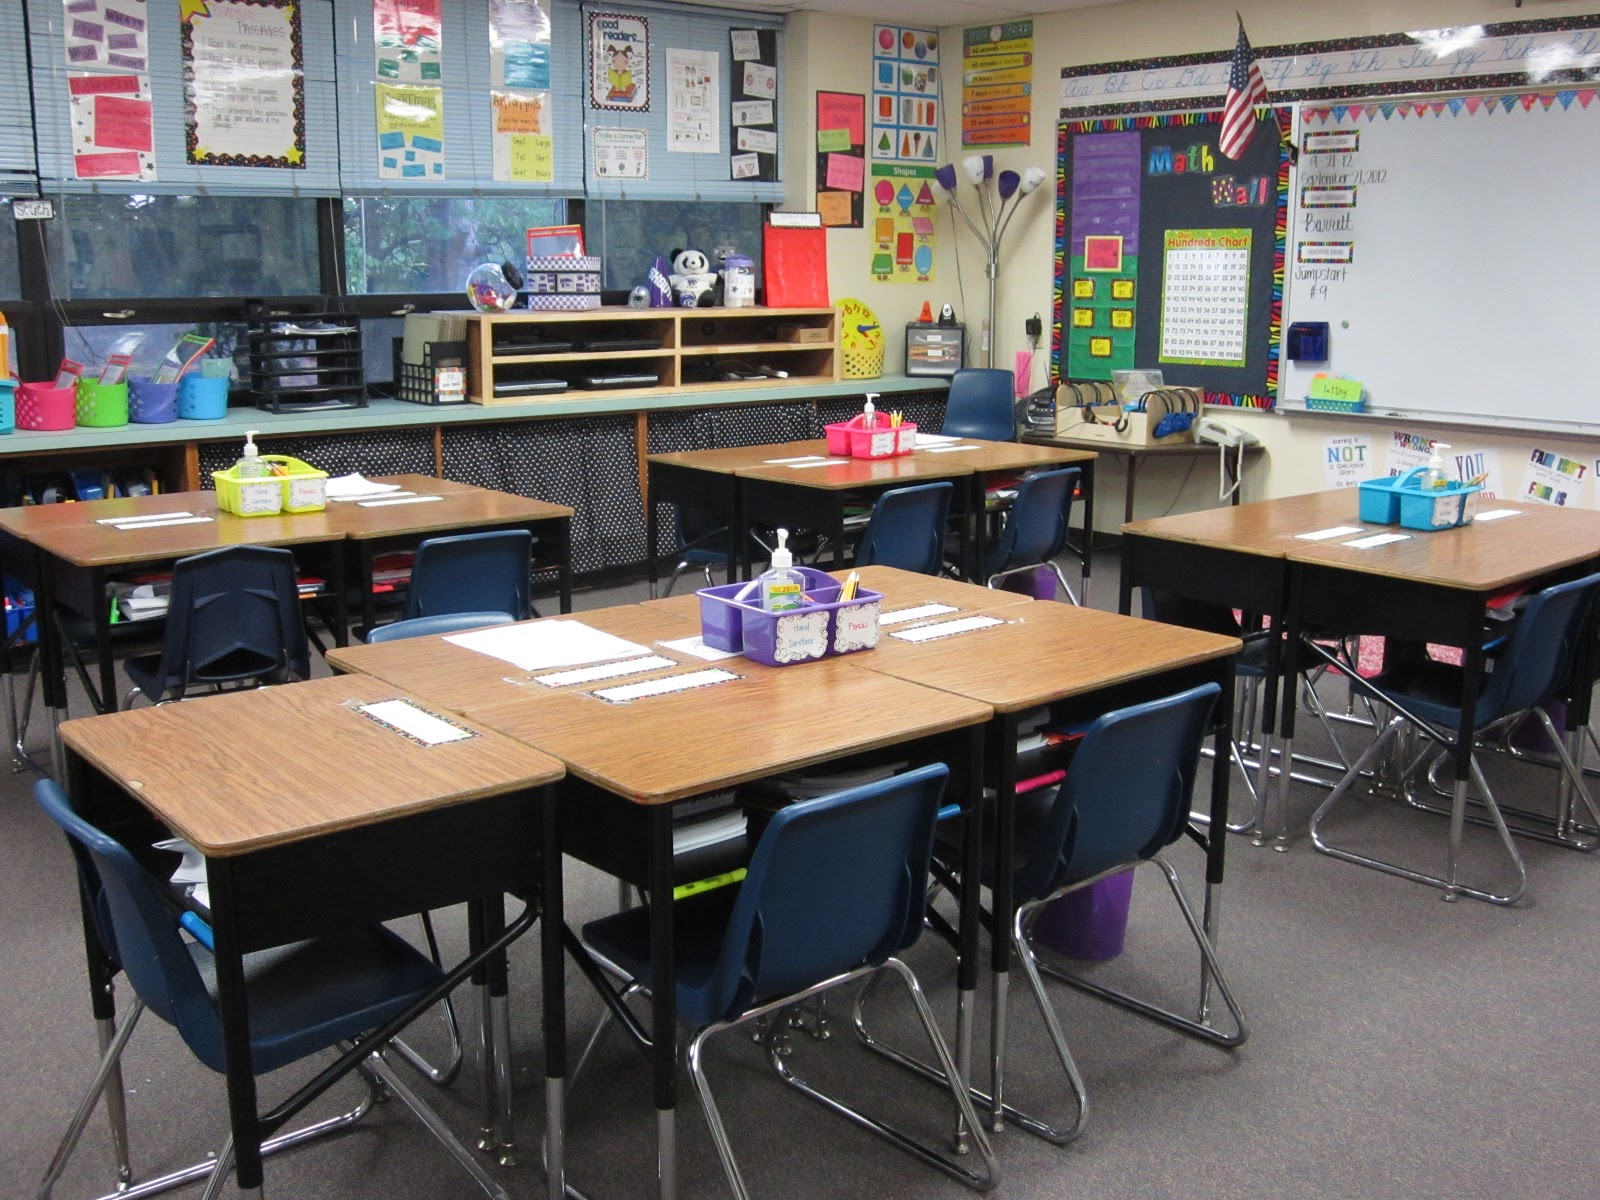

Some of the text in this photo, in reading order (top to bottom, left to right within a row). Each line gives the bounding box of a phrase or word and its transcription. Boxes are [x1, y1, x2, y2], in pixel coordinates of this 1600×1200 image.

[238, 21, 286, 37] PASSAGES
[1149, 145, 1215, 173] Math
[893, 167, 917, 177] Shapes
[1301, 171, 1349, 186] September
[1212, 177, 1267, 205] Wall
[16, 202, 50, 216] South
[1168, 236, 1248, 247] Hundreds Chart
[1294, 267, 1349, 285] Jumpstart
[648, 267, 673, 302] SHOUT
[844, 304, 853, 314] 10
[853, 304, 860, 313] 11
[862, 308, 870, 318] 12
[875, 331, 880, 339] 2
[1327, 445, 1367, 463] NOT
[1554, 491, 1567, 506] IS
[794, 622, 810, 632] Hand
